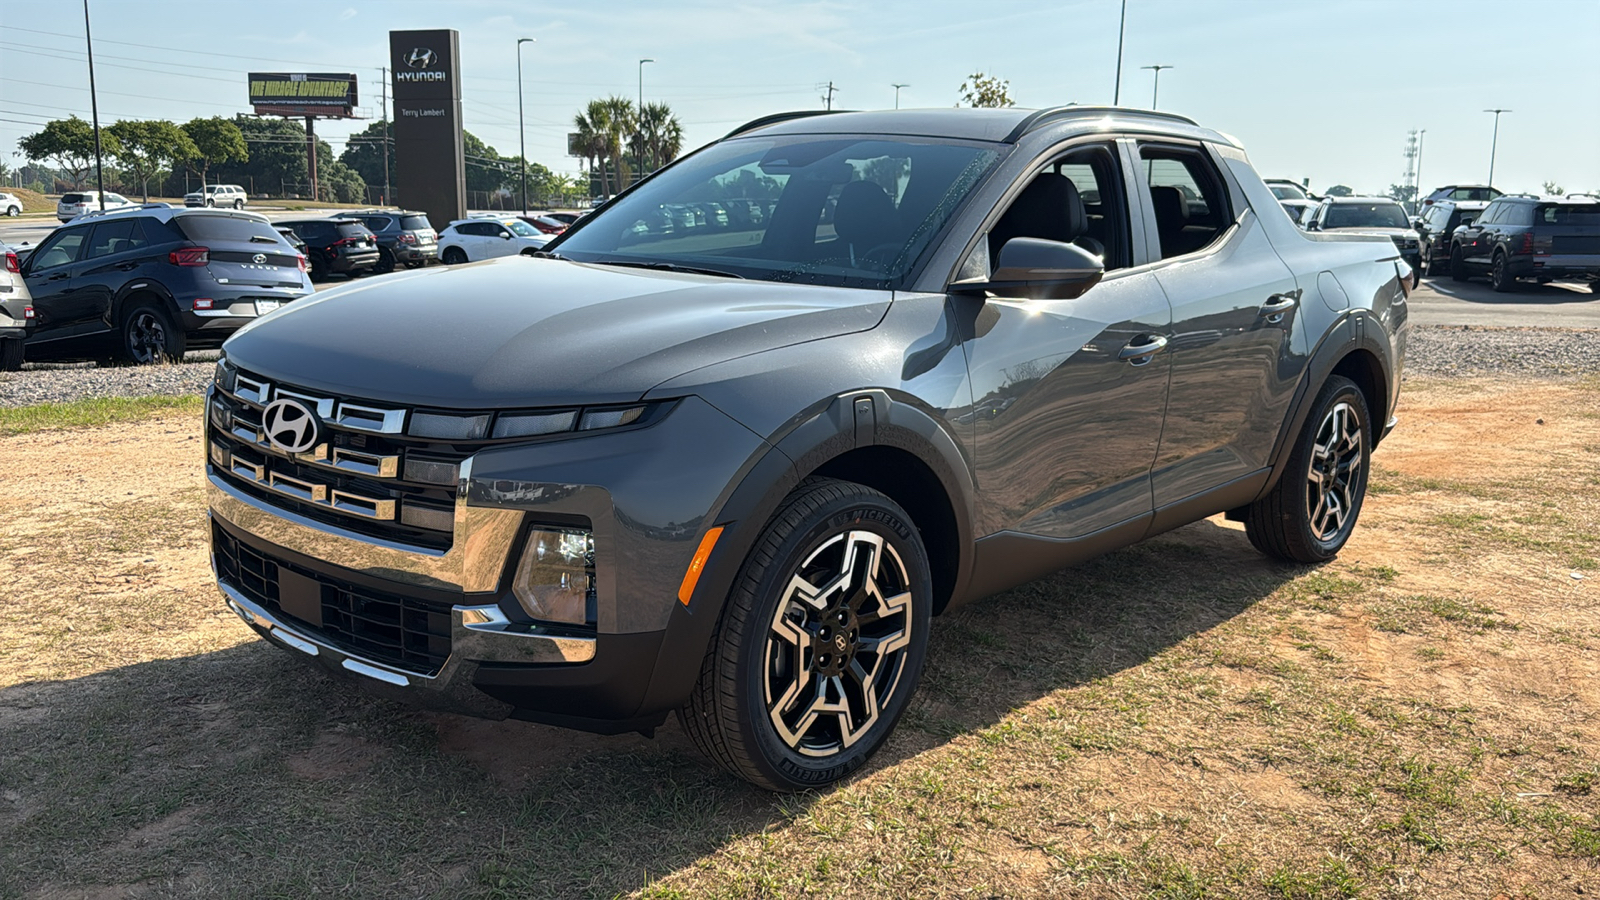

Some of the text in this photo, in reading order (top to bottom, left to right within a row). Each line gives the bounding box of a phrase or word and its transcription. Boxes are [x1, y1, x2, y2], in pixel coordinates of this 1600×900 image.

[397, 71, 446, 82] HYUNDAI
[251, 80, 349, 98] THE MIRACLE ADVANTAGE?
[402, 108, 445, 118] Terry Lambert
[851, 509, 909, 537] MICHELIN
[782, 760, 845, 781] MICHELIN
